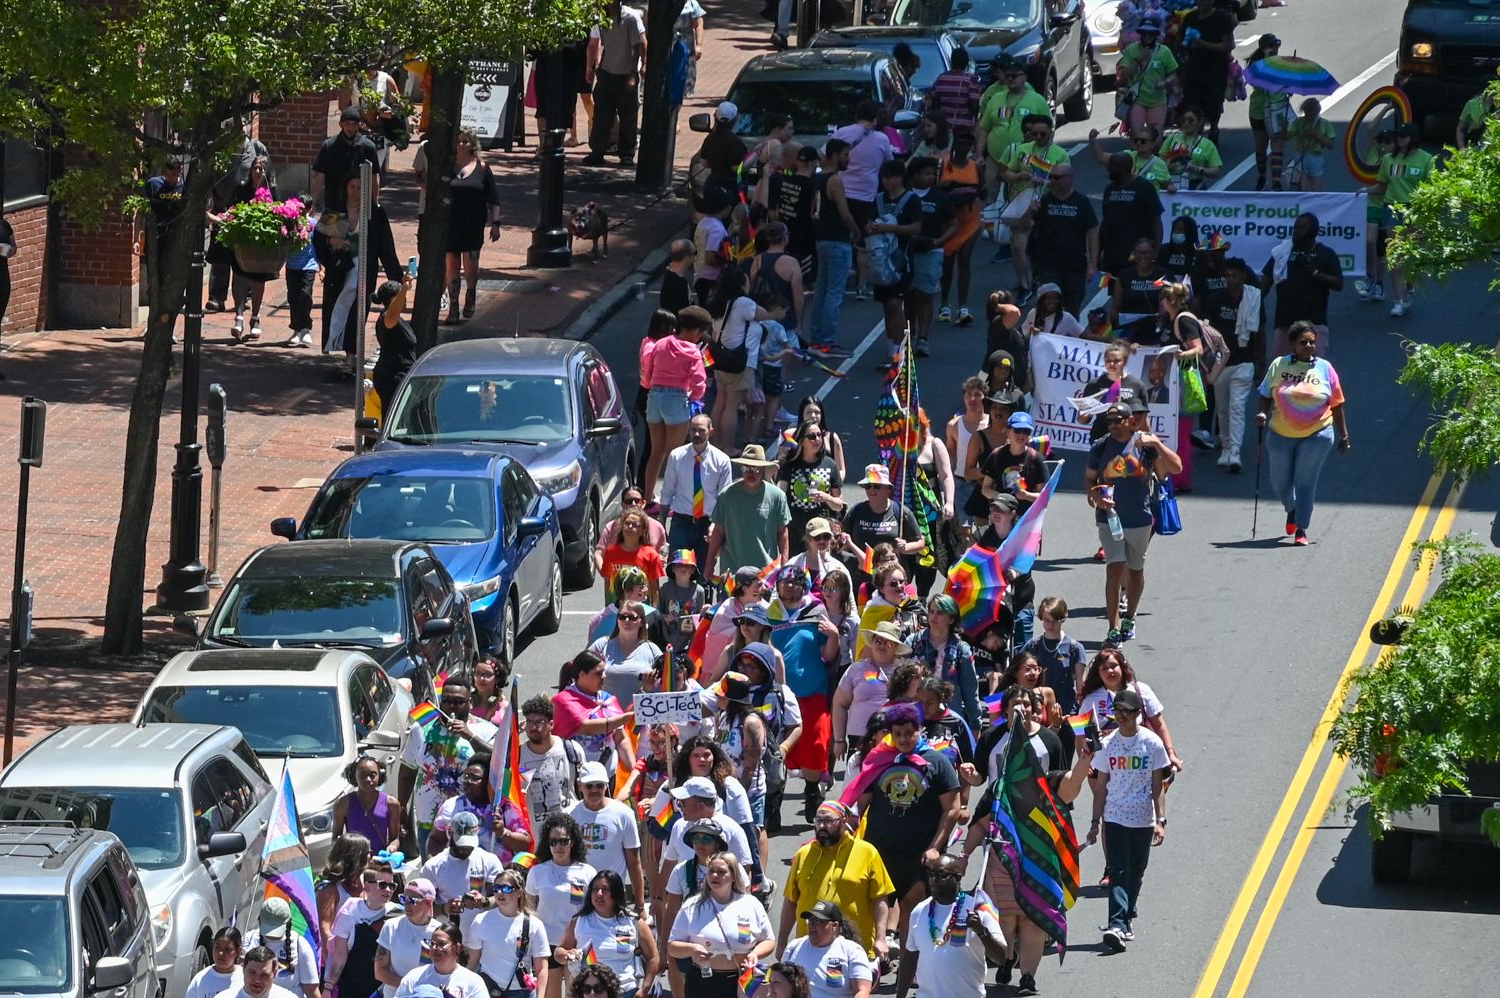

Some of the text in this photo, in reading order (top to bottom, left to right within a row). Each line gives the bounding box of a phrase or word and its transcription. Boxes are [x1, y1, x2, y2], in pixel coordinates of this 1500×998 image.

[468, 60, 509, 69] NTRANCE
[1171, 203, 1300, 218] Forever Proud
[1245, 220, 1360, 240] Progrsing.
[1059, 345, 1106, 367] MAL
[1048, 362, 1098, 384] BRO
[1039, 402, 1079, 423] STAT
[1034, 425, 1091, 445] HAMPDE
[872, 520, 897, 528] BELONG
[1109, 756, 1150, 771] PRIDE
